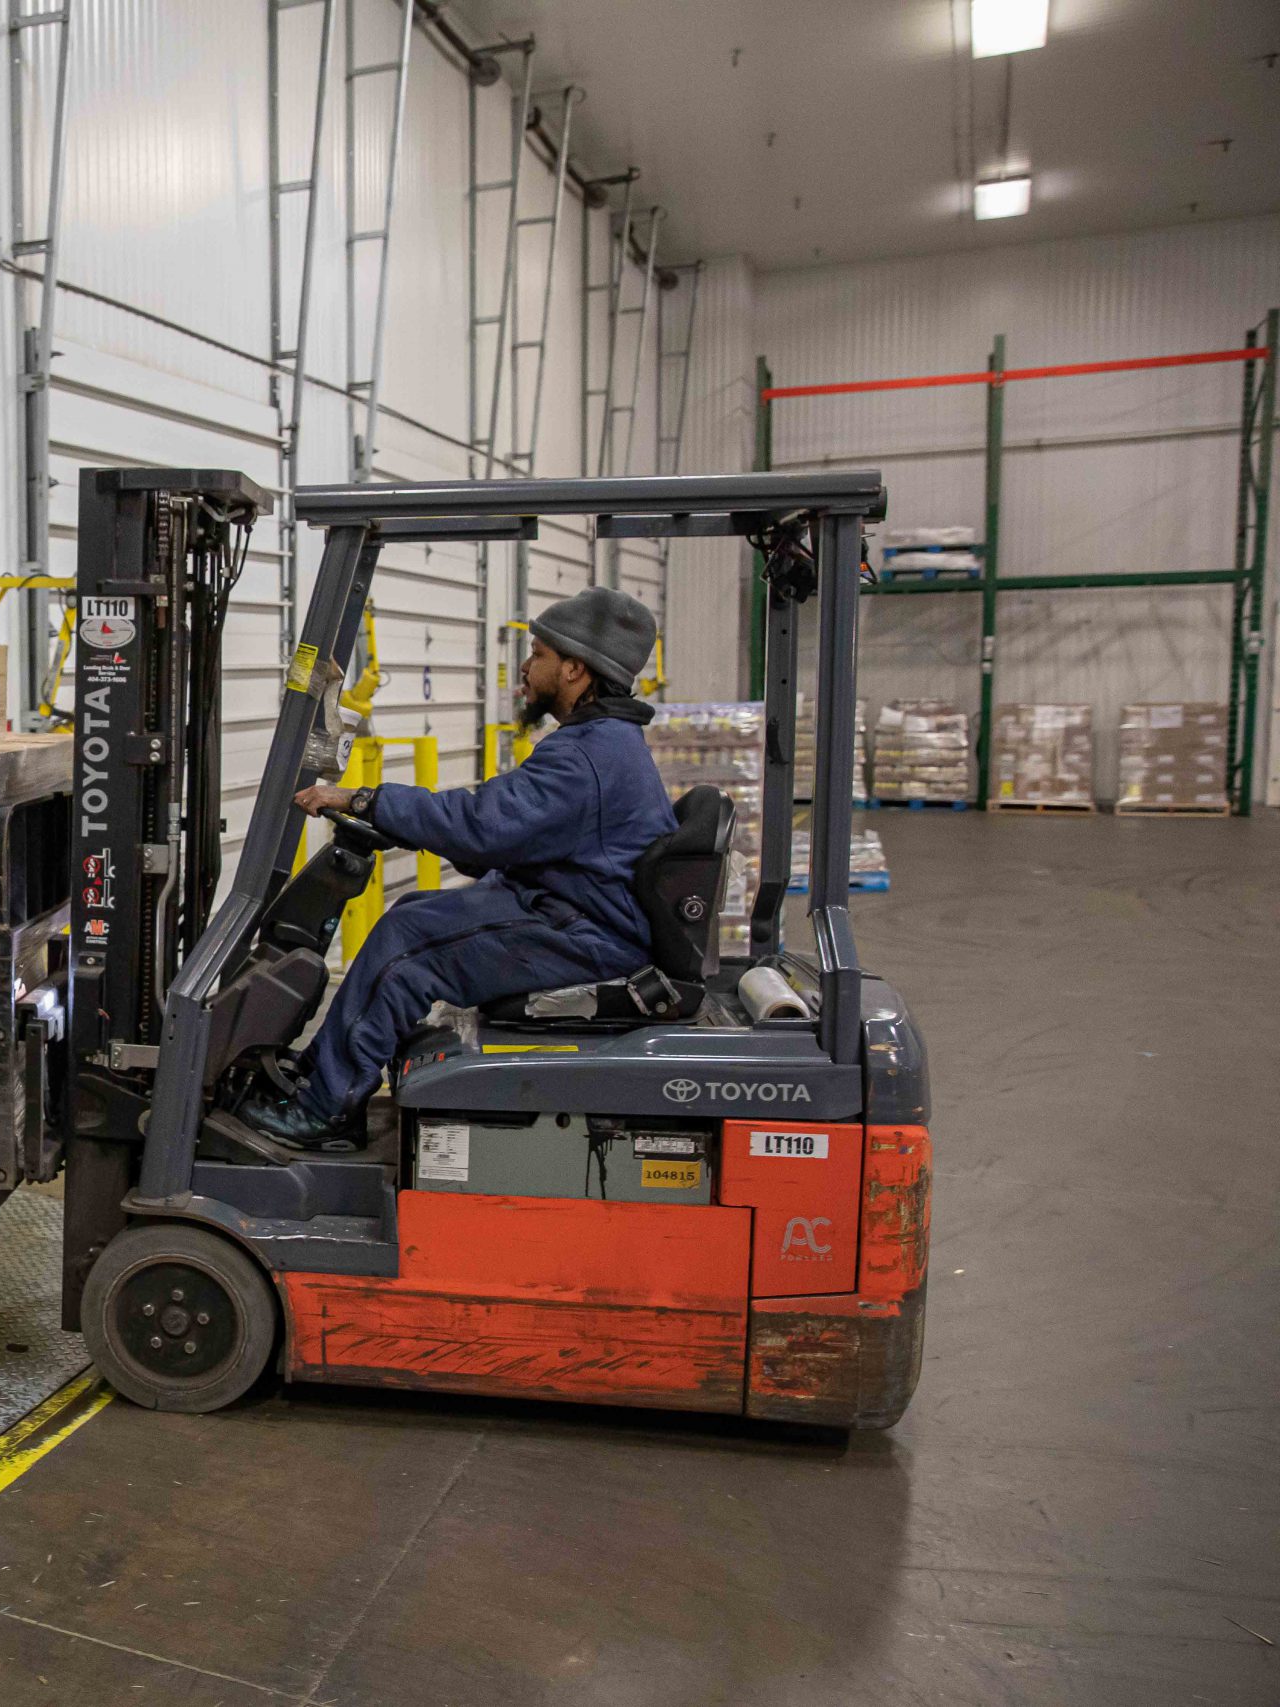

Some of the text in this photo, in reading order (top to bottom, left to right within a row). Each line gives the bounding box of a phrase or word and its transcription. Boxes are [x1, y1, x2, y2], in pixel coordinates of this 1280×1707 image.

[87, 600, 128, 616] LT110
[422, 666, 431, 700] 6
[81, 686, 111, 837] TOYOTA
[84, 919, 110, 935] AMC
[705, 1082, 812, 1102] TOYOTA
[765, 1135, 814, 1155] LT110
[645, 1169, 695, 1181] 104815
[781, 1216, 832, 1254] AC
